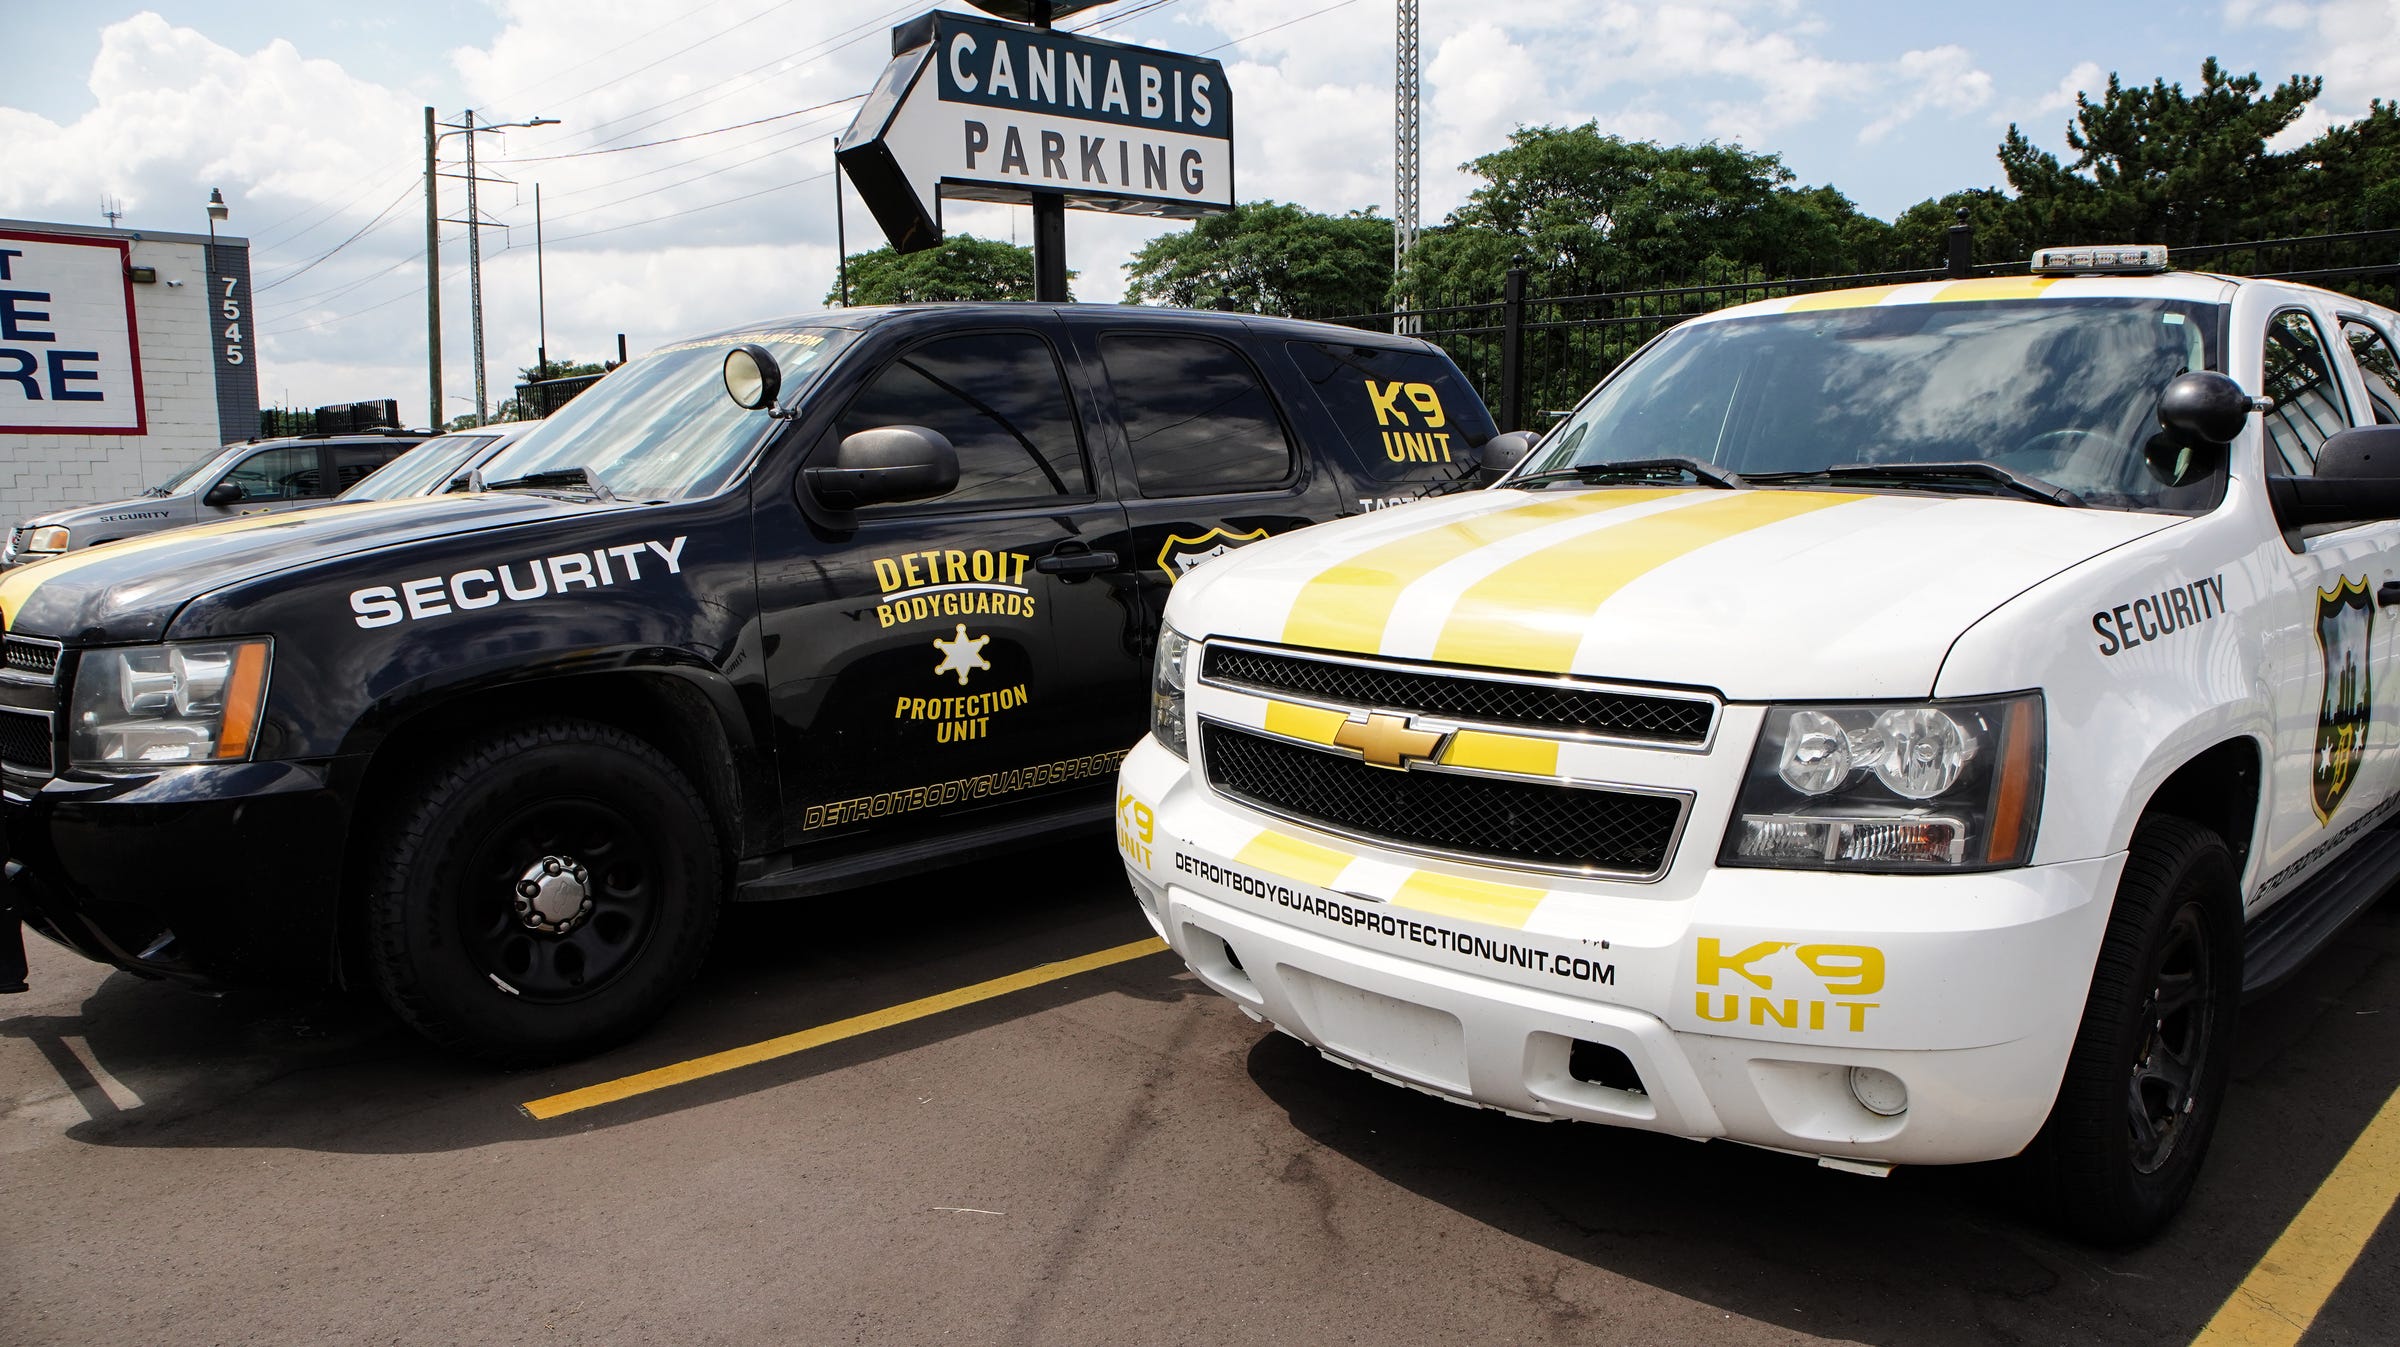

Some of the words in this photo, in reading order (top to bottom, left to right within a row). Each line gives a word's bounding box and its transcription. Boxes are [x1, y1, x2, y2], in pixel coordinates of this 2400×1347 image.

[949, 32, 1212, 126] CANNABIS
[964, 120, 1204, 194] PARKING
[220, 276, 244, 366] 7545
[1365, 380, 1445, 427] K9
[1382, 431, 1451, 462] UNIT
[100, 511, 169, 523] SECURITY
[350, 536, 687, 629] SECURITY
[873, 550, 1030, 593] DETROIT
[877, 593, 1035, 628] BODYGUARDS
[2092, 574, 2224, 656] SECURITY
[896, 684, 1028, 719] PROTECTION
[937, 717, 989, 743] UNIT
[1118, 785, 1154, 844] K9
[1118, 824, 1152, 871] UNIT
[1175, 852, 1616, 986] DETROITBODYGUARDSPROTECTIONUNIT.COM
[1697, 937, 1886, 996] K9
[1696, 992, 1880, 1032] UNIT
